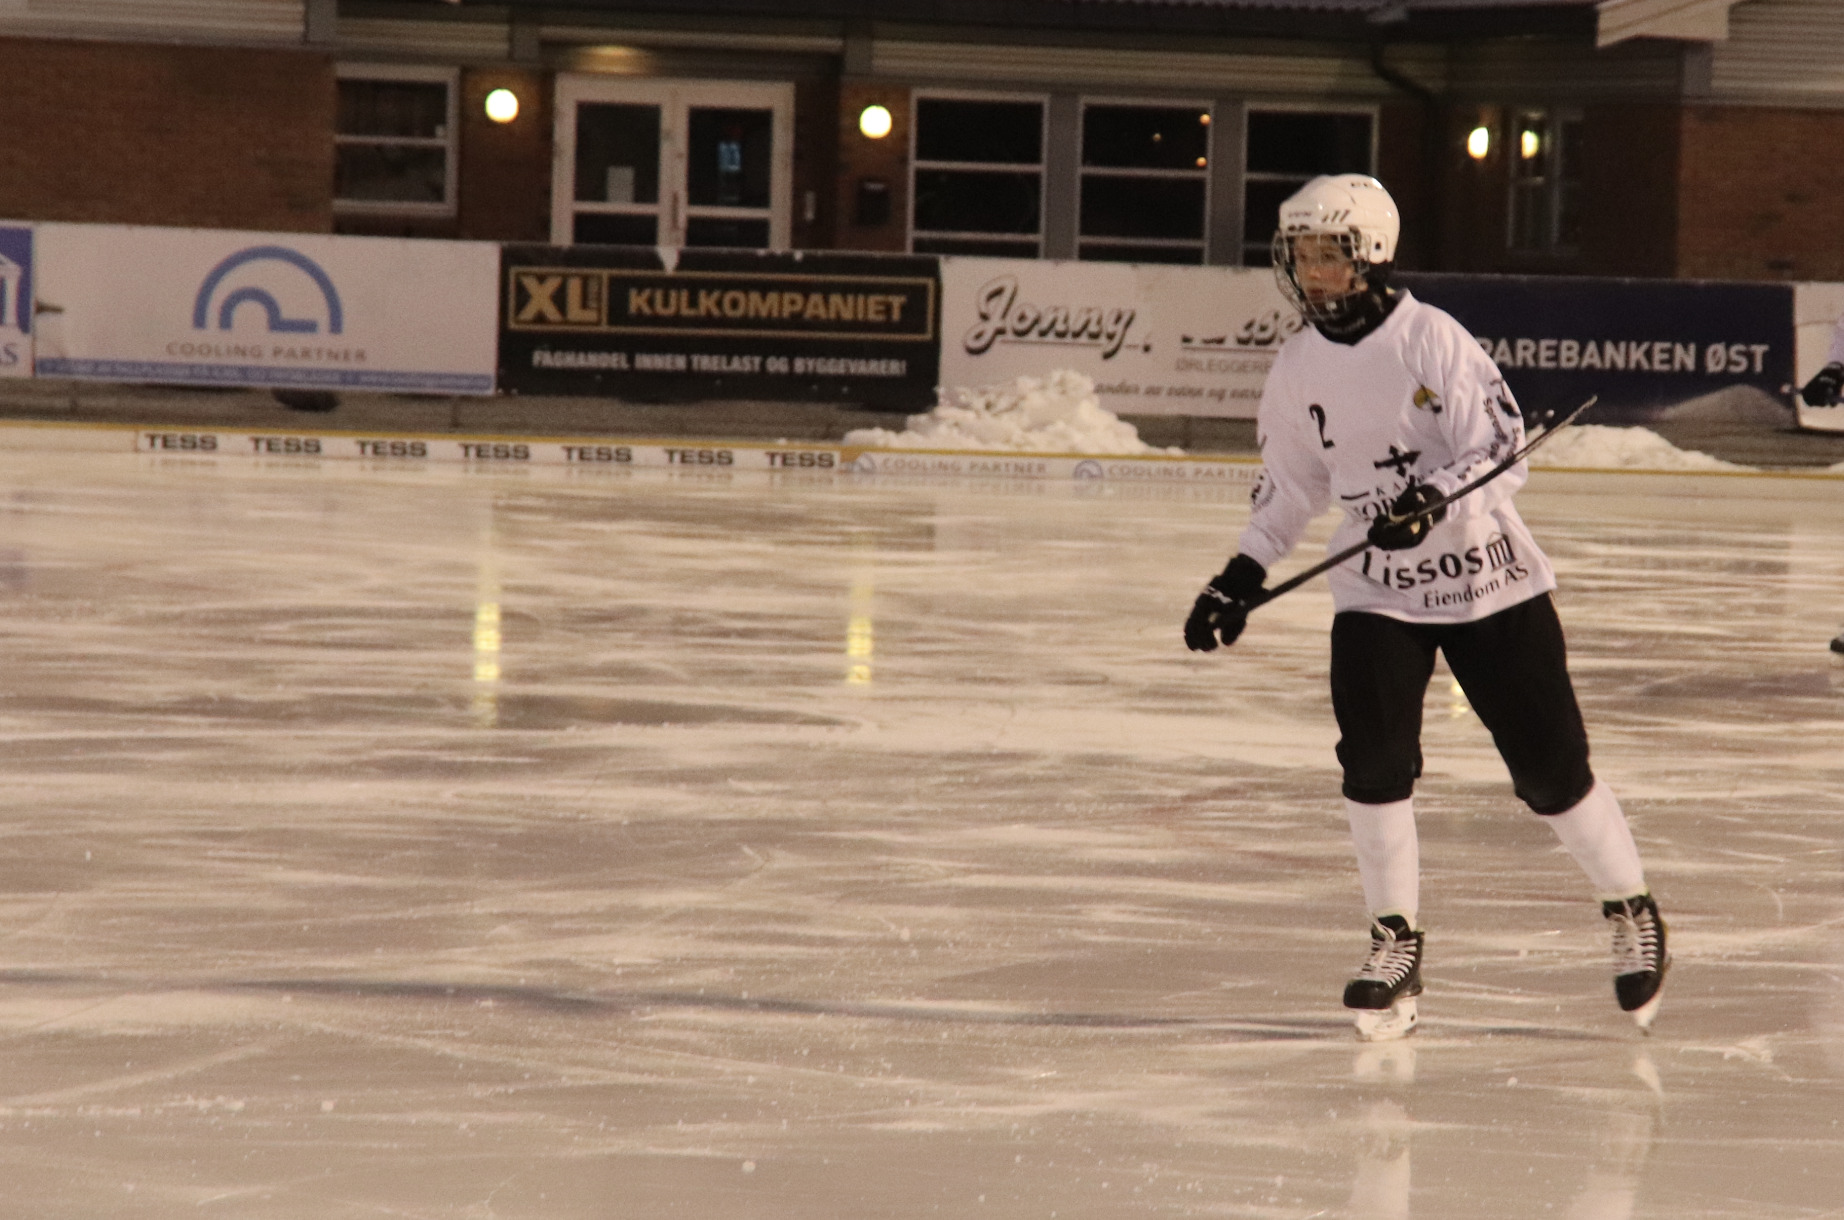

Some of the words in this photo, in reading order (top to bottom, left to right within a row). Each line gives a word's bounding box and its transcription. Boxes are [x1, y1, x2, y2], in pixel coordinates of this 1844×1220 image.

[517, 275, 598, 322] XL
[628, 286, 907, 321] KULKOMPANIET
[165, 341, 263, 358] COOLING
[272, 345, 367, 362] PARTNER
[634, 352, 688, 371] INNEN
[690, 353, 763, 373] TRELAST
[765, 355, 790, 374] OG
[1705, 341, 1770, 374] ØST
[1309, 403, 1335, 449] 2
[145, 433, 218, 451] TESS
[249, 436, 322, 454] TESS
[355, 439, 427, 457] TESS
[458, 442, 530, 460] TESS
[562, 444, 633, 462] TESS
[663, 447, 734, 465] TESS
[764, 450, 835, 468] TESS
[881, 457, 963, 473] COOLING
[969, 460, 1047, 475] PARTNER
[1107, 465, 1187, 479] COOLING
[1423, 578, 1501, 609] Eiendom
[1504, 561, 1530, 586] AS
